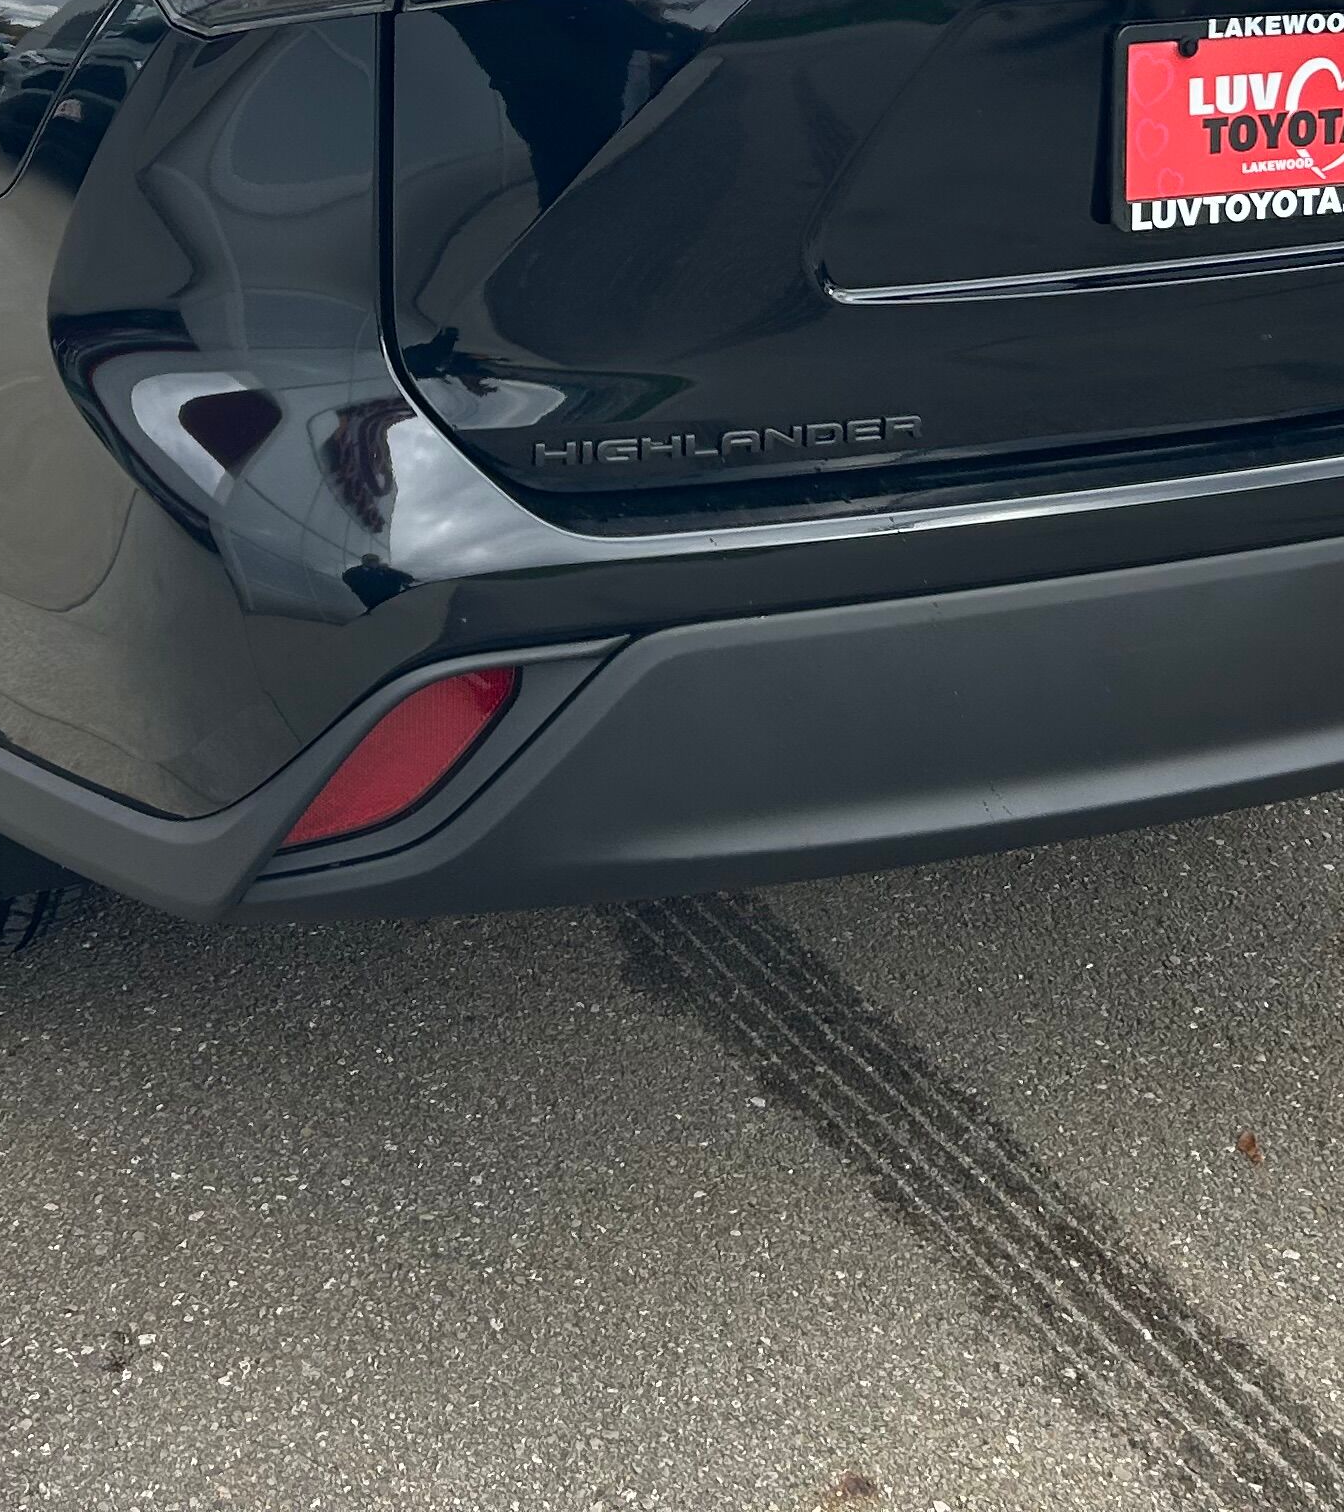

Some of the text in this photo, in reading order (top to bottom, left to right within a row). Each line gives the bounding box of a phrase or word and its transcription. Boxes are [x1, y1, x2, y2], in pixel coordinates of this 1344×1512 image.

[1188, 72, 1283, 116] LUV
[1241, 156, 1314, 175] LAKEWOOD
[532, 414, 924, 467] HIGHLANDER
